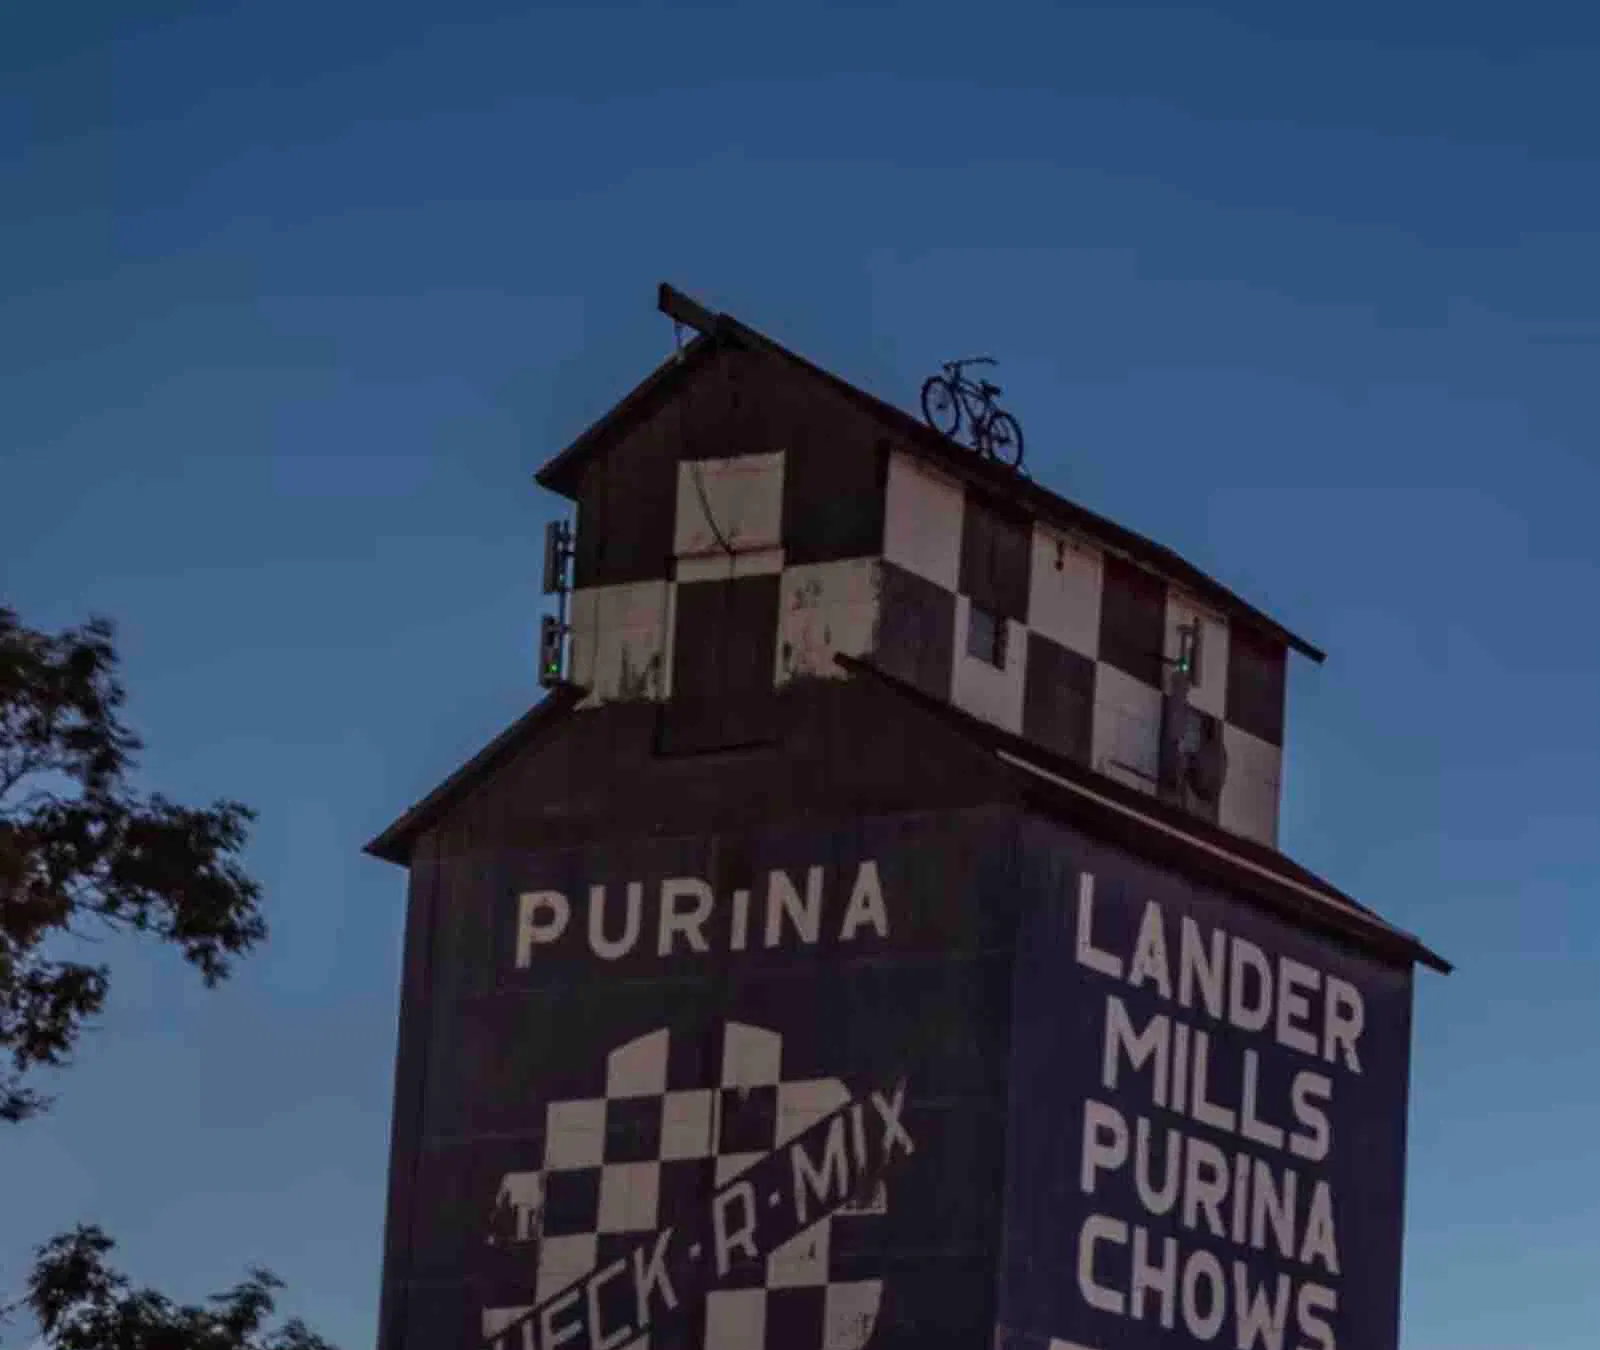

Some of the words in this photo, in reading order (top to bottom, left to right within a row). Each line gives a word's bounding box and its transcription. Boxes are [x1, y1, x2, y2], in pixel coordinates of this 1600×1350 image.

[514, 858, 889, 969] PURINA
[1075, 871, 1364, 1074] LANDER
[1103, 994, 1334, 1163] MILLS
[1080, 1097, 1341, 1276] PURINA
